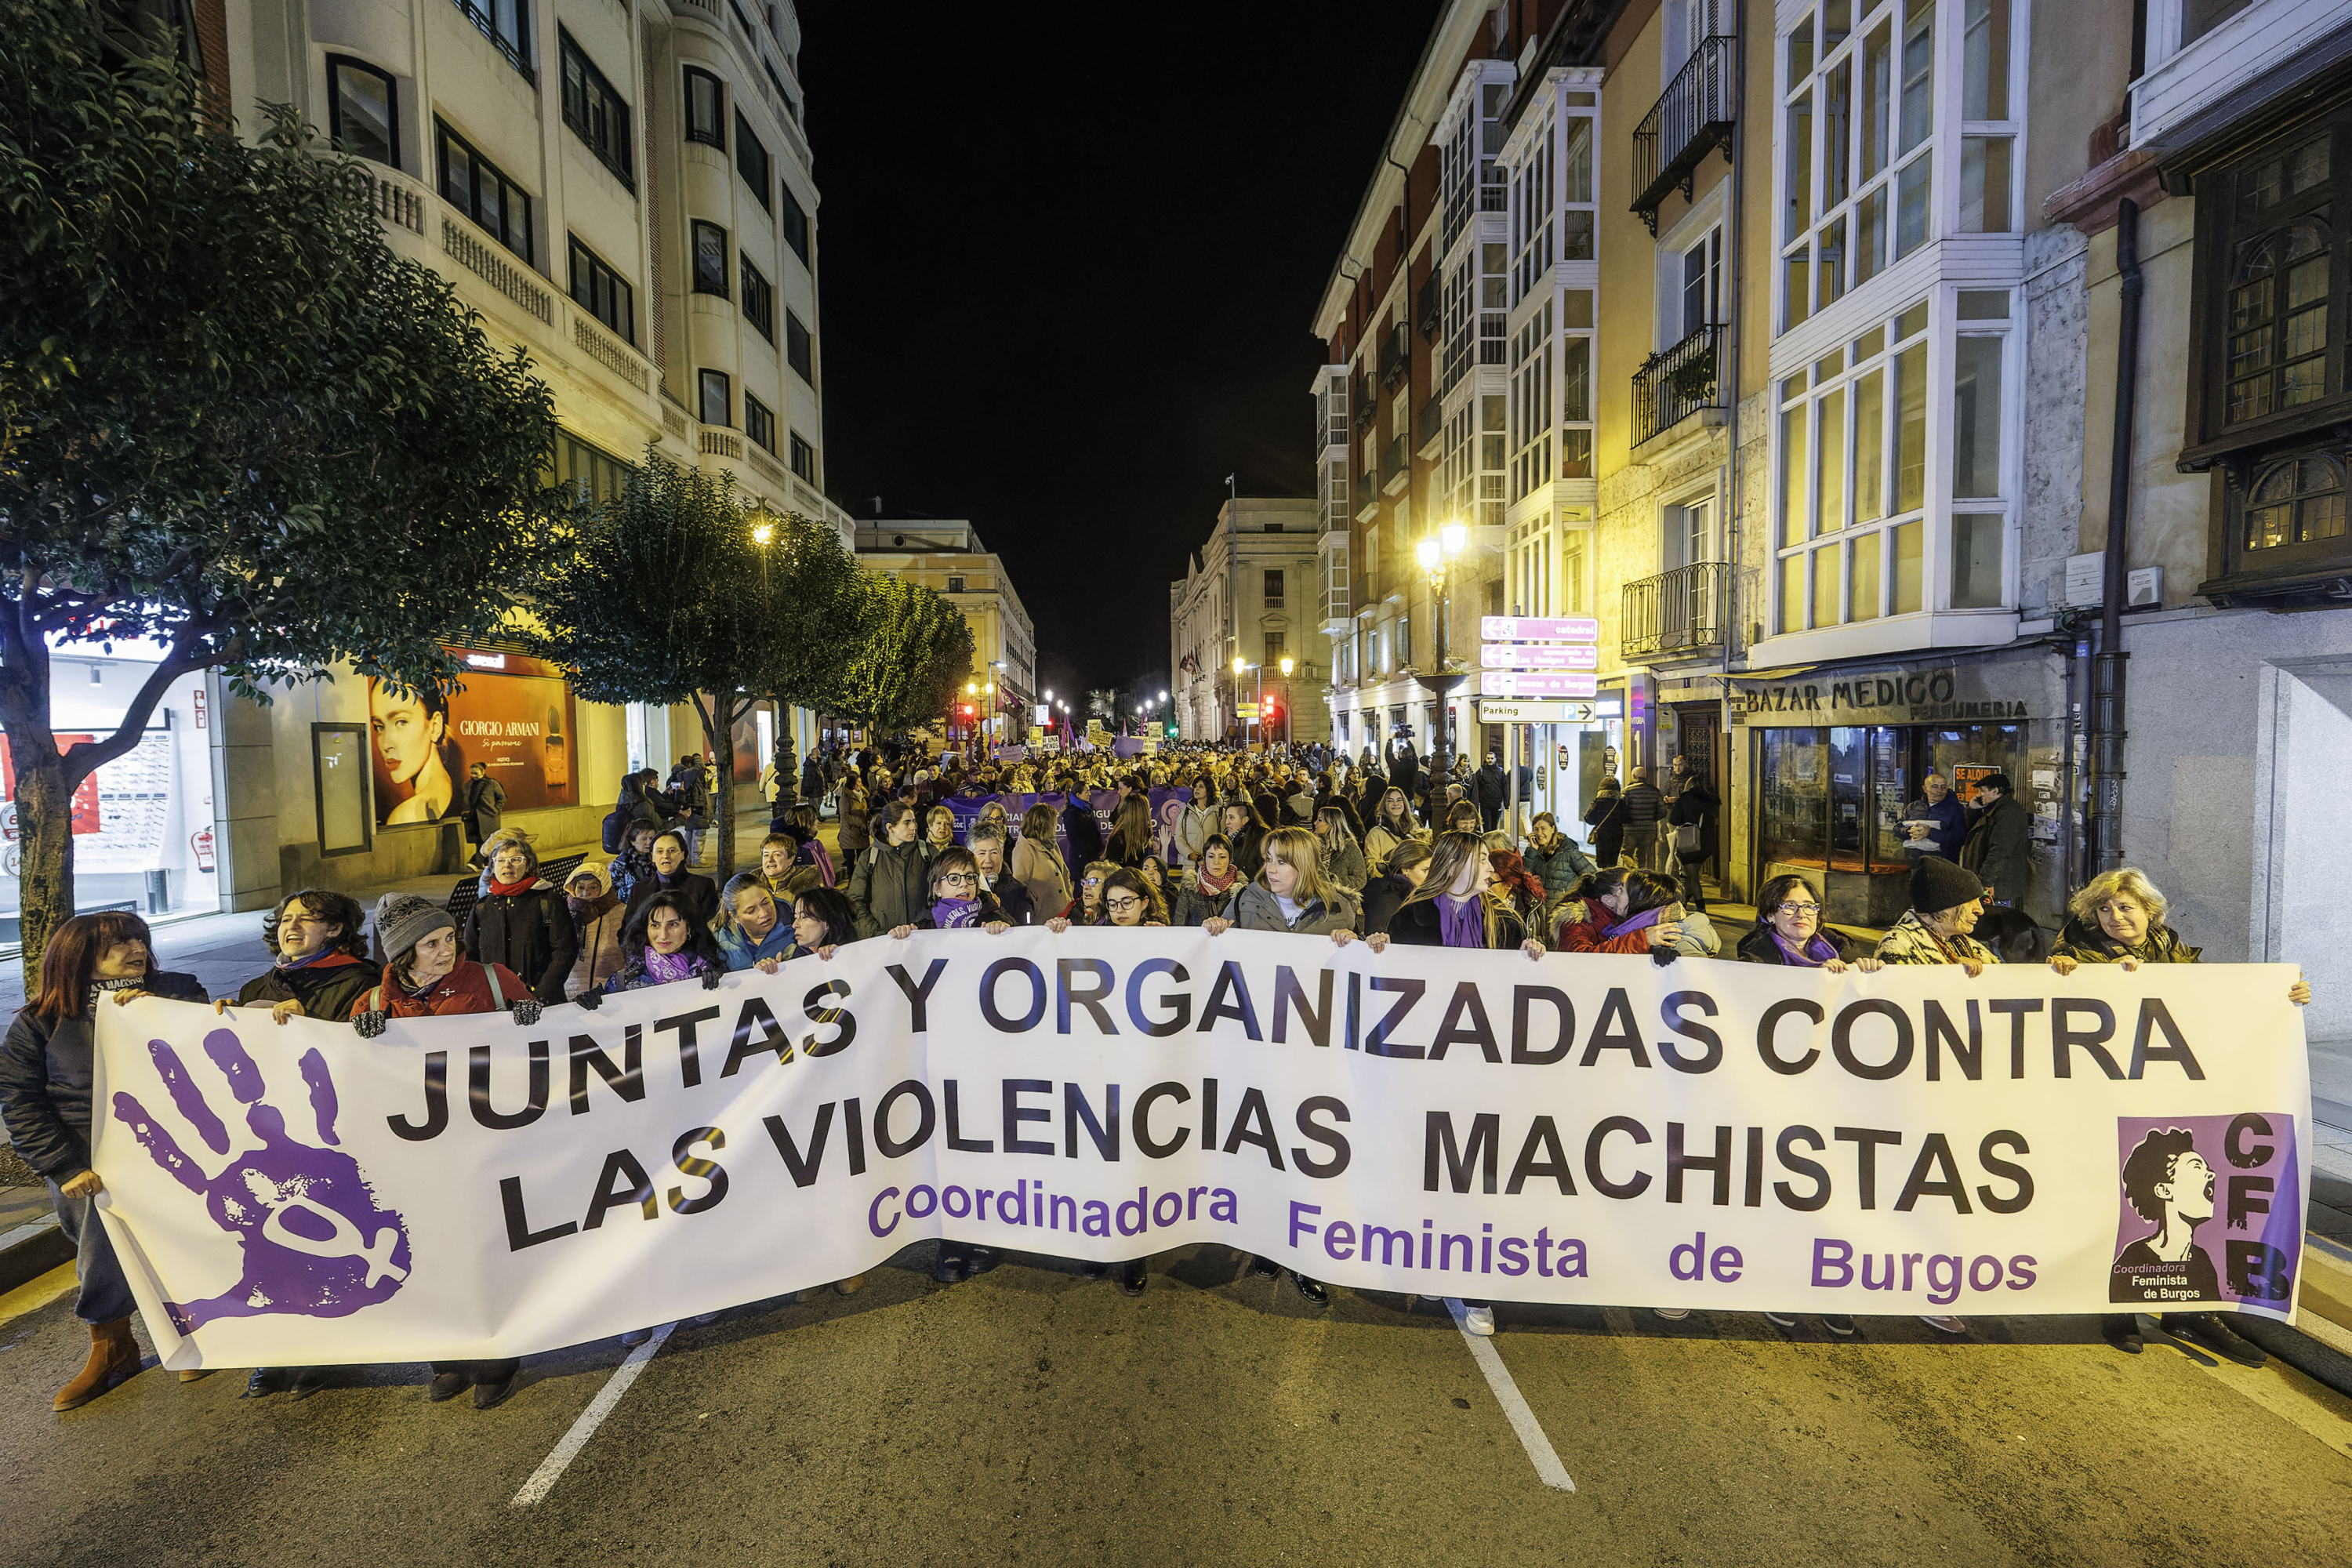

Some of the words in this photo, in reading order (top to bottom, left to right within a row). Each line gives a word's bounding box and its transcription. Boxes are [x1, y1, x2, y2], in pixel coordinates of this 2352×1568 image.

[1555, 625, 1595, 634] catedral
[1747, 684, 1821, 713] BAZAR
[1831, 675, 1955, 710] MEDICO
[1483, 706, 1519, 716] Parking
[459, 720, 503, 736] GIORGIO
[505, 721, 539, 736] ARMANI
[1955, 768, 1965, 780] SE
[386, 978, 857, 1142] JUNTAS
[884, 958, 949, 1033] Y
[978, 956, 1723, 1075] ORGANIZADAS
[1756, 997, 2206, 1082] CONTRA
[499, 1126, 730, 1253] LAS
[762, 1077, 1352, 1189] VIOLENCIAS
[1423, 1110, 2034, 1215] MACHISTAS
[868, 1178, 1239, 1238] Coordinadora
[1288, 1200, 1588, 1279] Feminista
[1668, 1231, 1744, 1283] de
[1810, 1237, 2038, 1305] Burgos
[2113, 1263, 2187, 1274] Coordinadora
[2132, 1274, 2188, 1287] Feminista
[2143, 1288, 2158, 1299] de
[2160, 1288, 2201, 1301] Burgos
